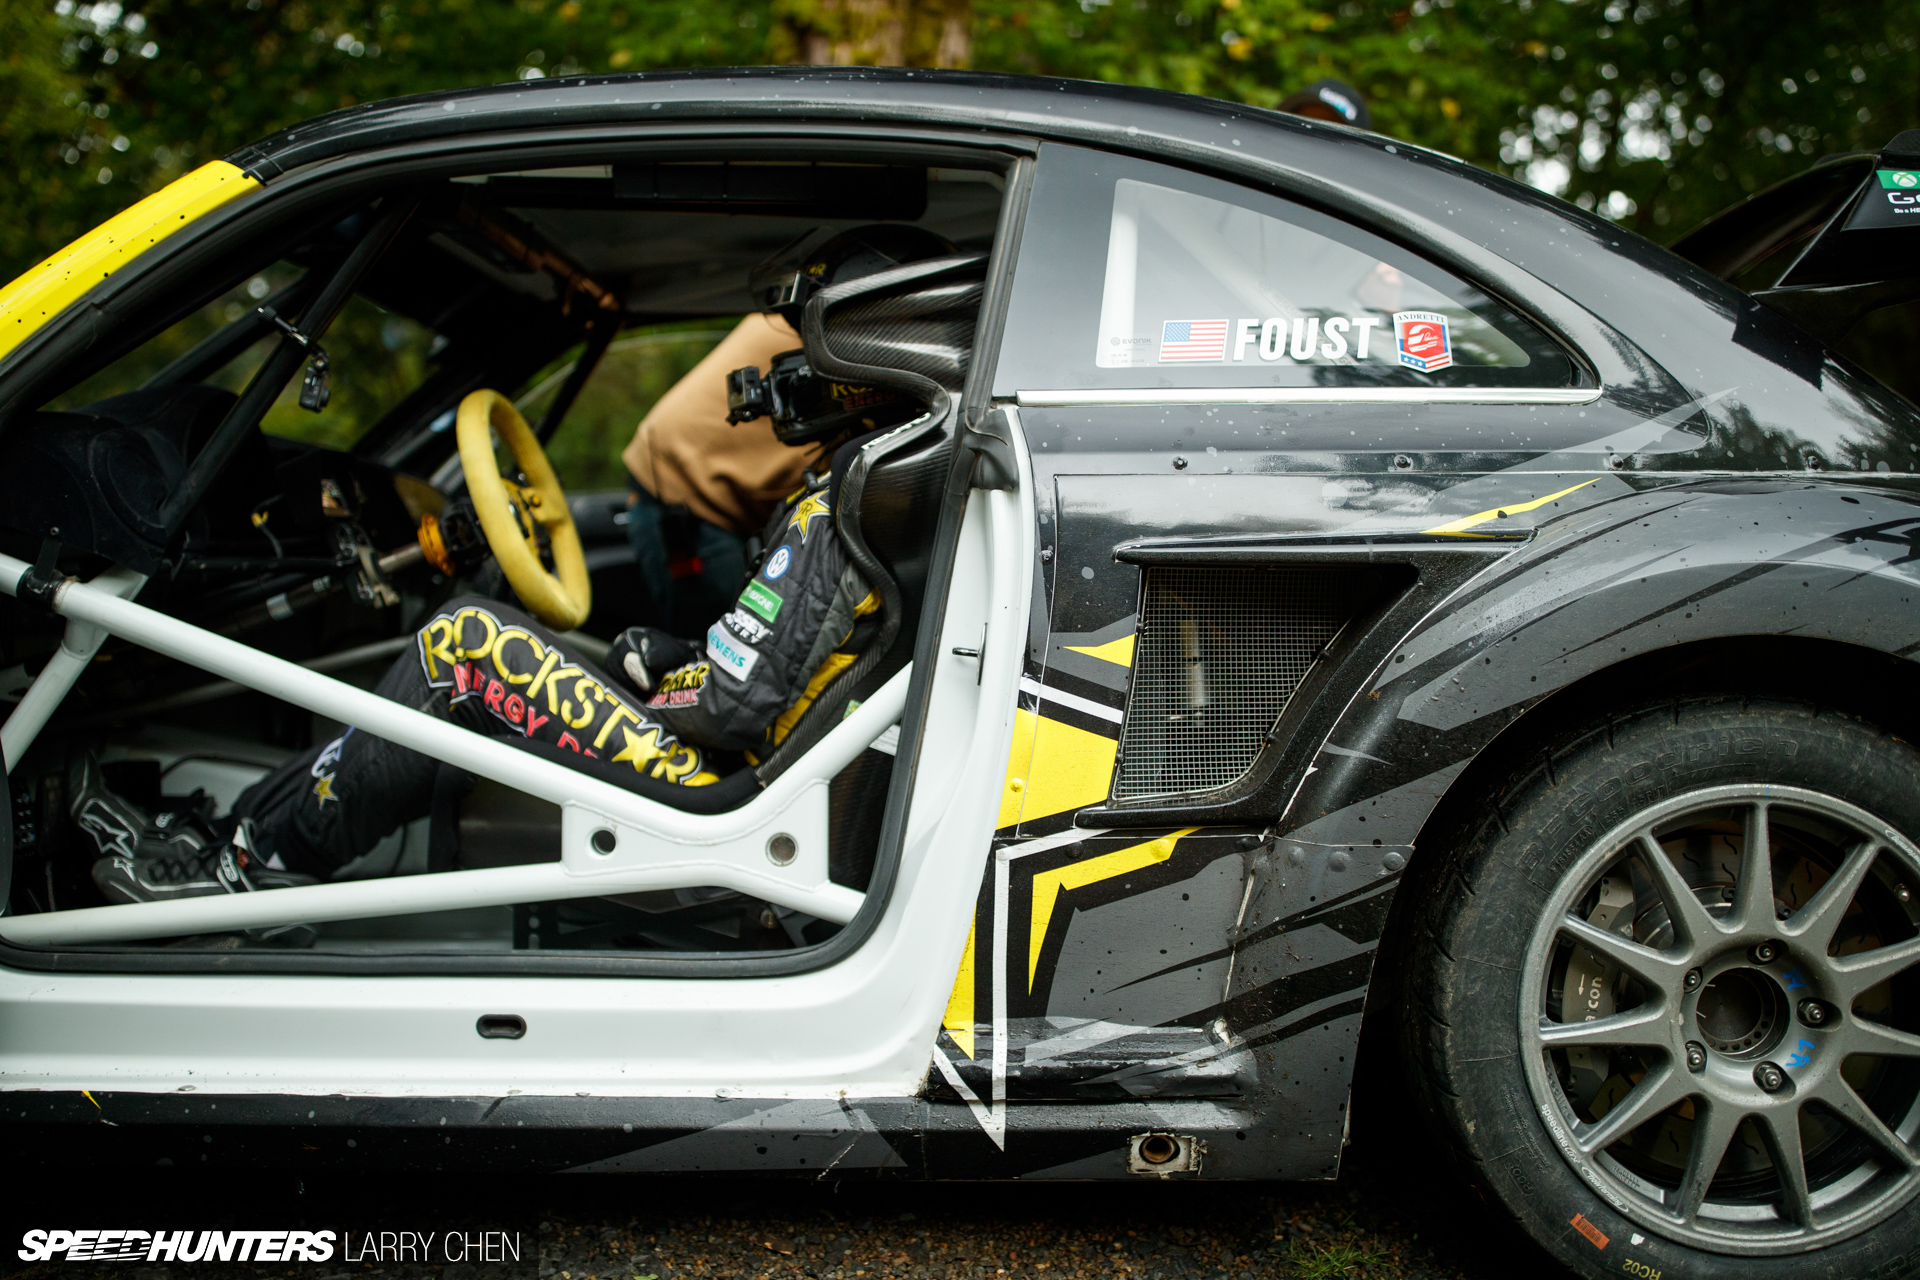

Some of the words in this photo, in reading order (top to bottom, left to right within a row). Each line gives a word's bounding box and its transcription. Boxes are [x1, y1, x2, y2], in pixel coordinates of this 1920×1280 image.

[1233, 317, 1379, 362] FOUST
[1397, 313, 1445, 323] ANDRETTI
[1512, 734, 1799, 880] BFGoodrich
[1541, 1103, 1568, 1148] speedline
[1622, 1259, 1661, 1280] RC02
